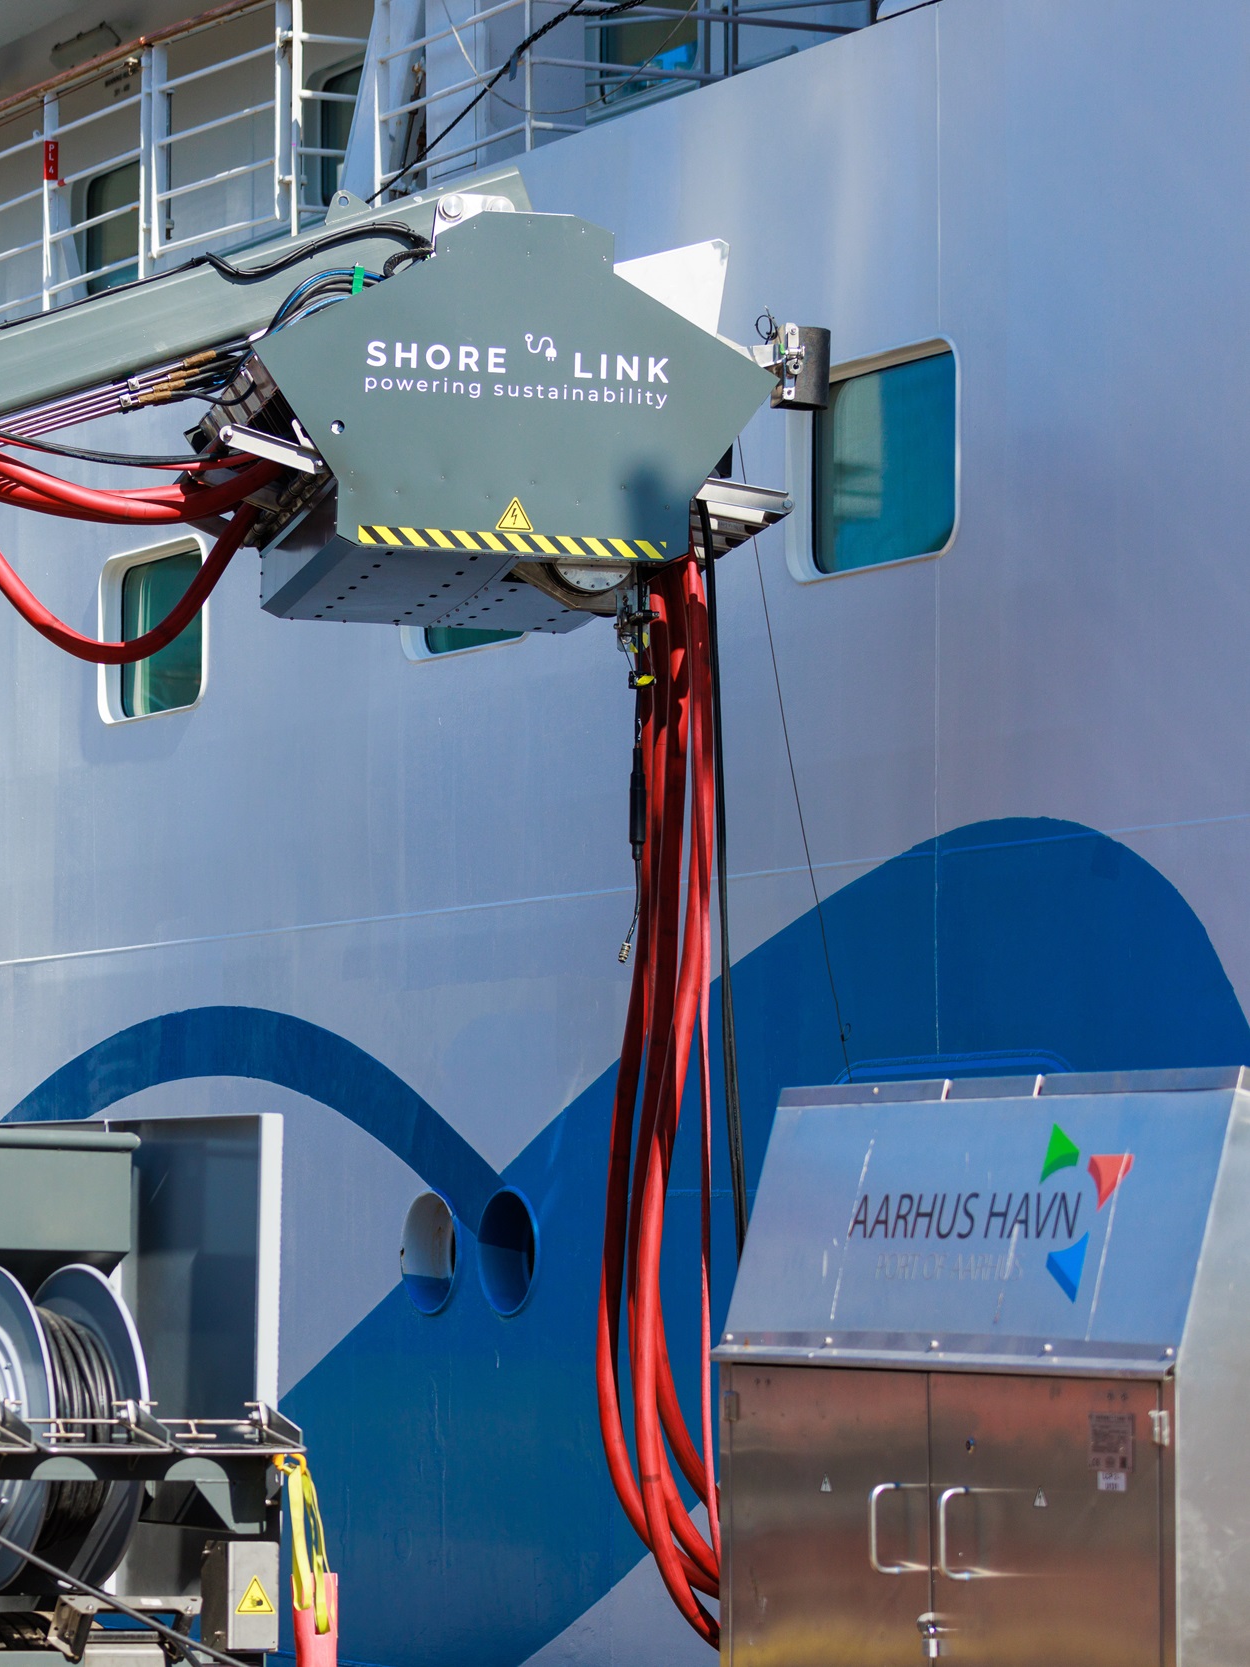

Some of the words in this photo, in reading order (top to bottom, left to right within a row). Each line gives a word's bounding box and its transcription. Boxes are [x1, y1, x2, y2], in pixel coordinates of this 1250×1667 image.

[365, 340, 507, 374] SHORE
[573, 352, 669, 384] LINK
[364, 375, 481, 399] powering
[493, 383, 669, 409] sustainability
[848, 1192, 979, 1239] AARHUS
[983, 1191, 1082, 1239] HAVN
[874, 1252, 921, 1281] PORT
[922, 1252, 948, 1281] OF
[950, 1252, 1025, 1281] AARHUS
